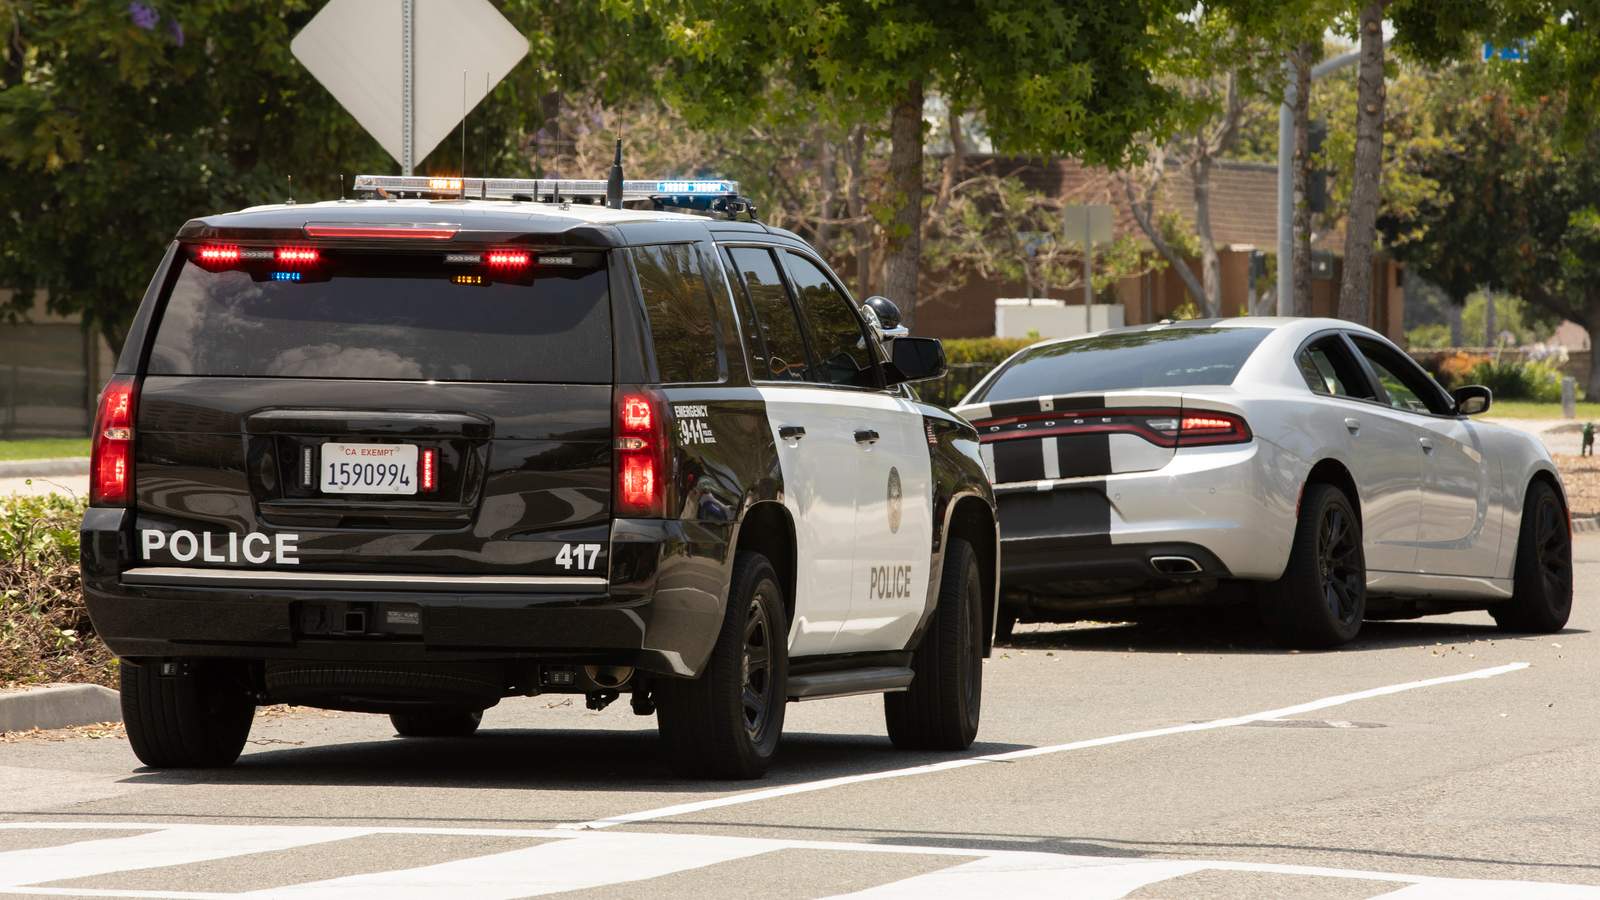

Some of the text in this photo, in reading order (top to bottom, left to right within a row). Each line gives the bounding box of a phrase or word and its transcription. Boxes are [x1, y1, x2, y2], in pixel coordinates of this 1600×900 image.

[674, 405, 708, 417] EMERGENCY
[345, 448, 394, 456] CA EXEMPT
[328, 462, 410, 487] 1590994
[141, 529, 300, 565] POLICE
[555, 543, 601, 570] 417
[869, 565, 912, 600] POLICE
